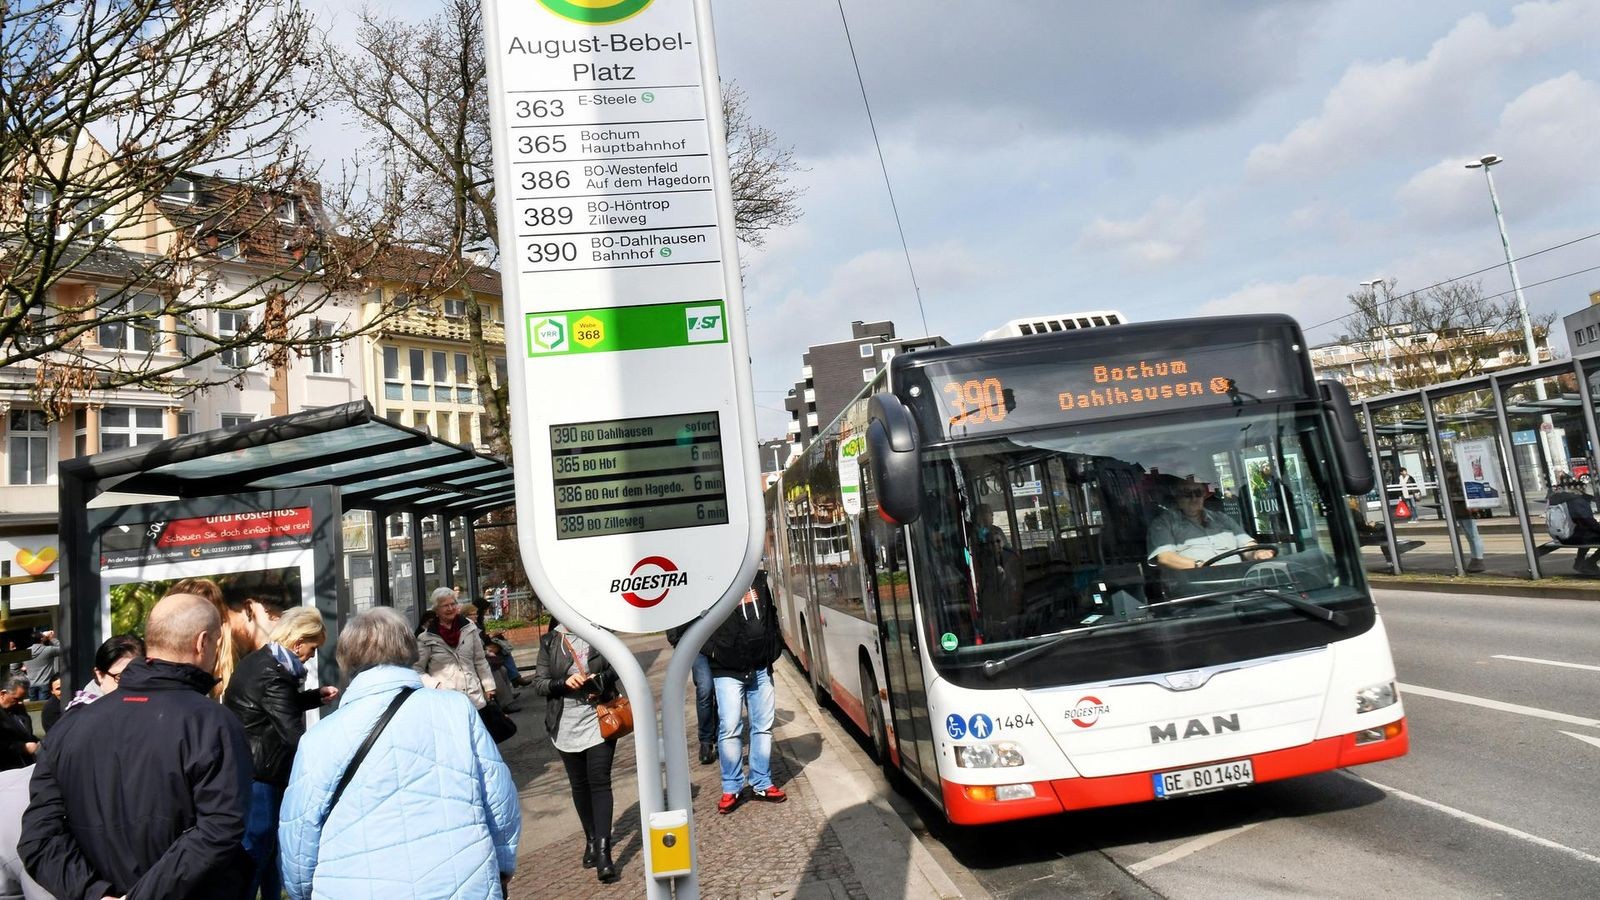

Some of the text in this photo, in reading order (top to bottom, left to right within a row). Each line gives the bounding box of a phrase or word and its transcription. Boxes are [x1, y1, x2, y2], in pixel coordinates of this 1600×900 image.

[508, 32, 692, 58] August-Bebel-
[573, 64, 636, 81] Platz
[516, 99, 564, 118] 363
[579, 94, 637, 105] E-Steele
[518, 135, 567, 154] 365
[581, 130, 640, 141] Bochum
[582, 139, 686, 154] Hauptbahnhof
[584, 162, 678, 177] BO-Westenfeld
[521, 170, 570, 190] 386
[586, 175, 711, 189] Auf dem Hagedorn
[587, 200, 670, 213] BO-Höntrop
[524, 207, 573, 227] 389
[589, 214, 647, 226] Zilleweg
[591, 234, 706, 248] BO-Dahlhausen
[527, 242, 577, 263] 390
[592, 248, 654, 261] Bahnhof
[577, 330, 600, 341] 368
[1093, 360, 1188, 383] Bochum
[944, 378, 1007, 424] 390
[1058, 380, 1202, 410] Dahlhausen
[554, 420, 717, 444] 390 BO Dahlhausen sofort
[556, 445, 720, 473] 365 BO Hbf 6 min
[558, 475, 722, 503] 386 BO Auf dem Hagedo. 6 min
[1260, 498, 1279, 513] JUN
[560, 504, 725, 533] 389 BO Zilleweg 6 min
[165, 519, 311, 543] Schauen Sie doch einfach mal rein!
[609, 572, 688, 593] BOGESTRA
[995, 713, 1035, 731] 1484
[1064, 705, 1111, 720] BOGESTRA
[1149, 713, 1240, 744] MAN
[1164, 763, 1250, 792] GE BO 1484
